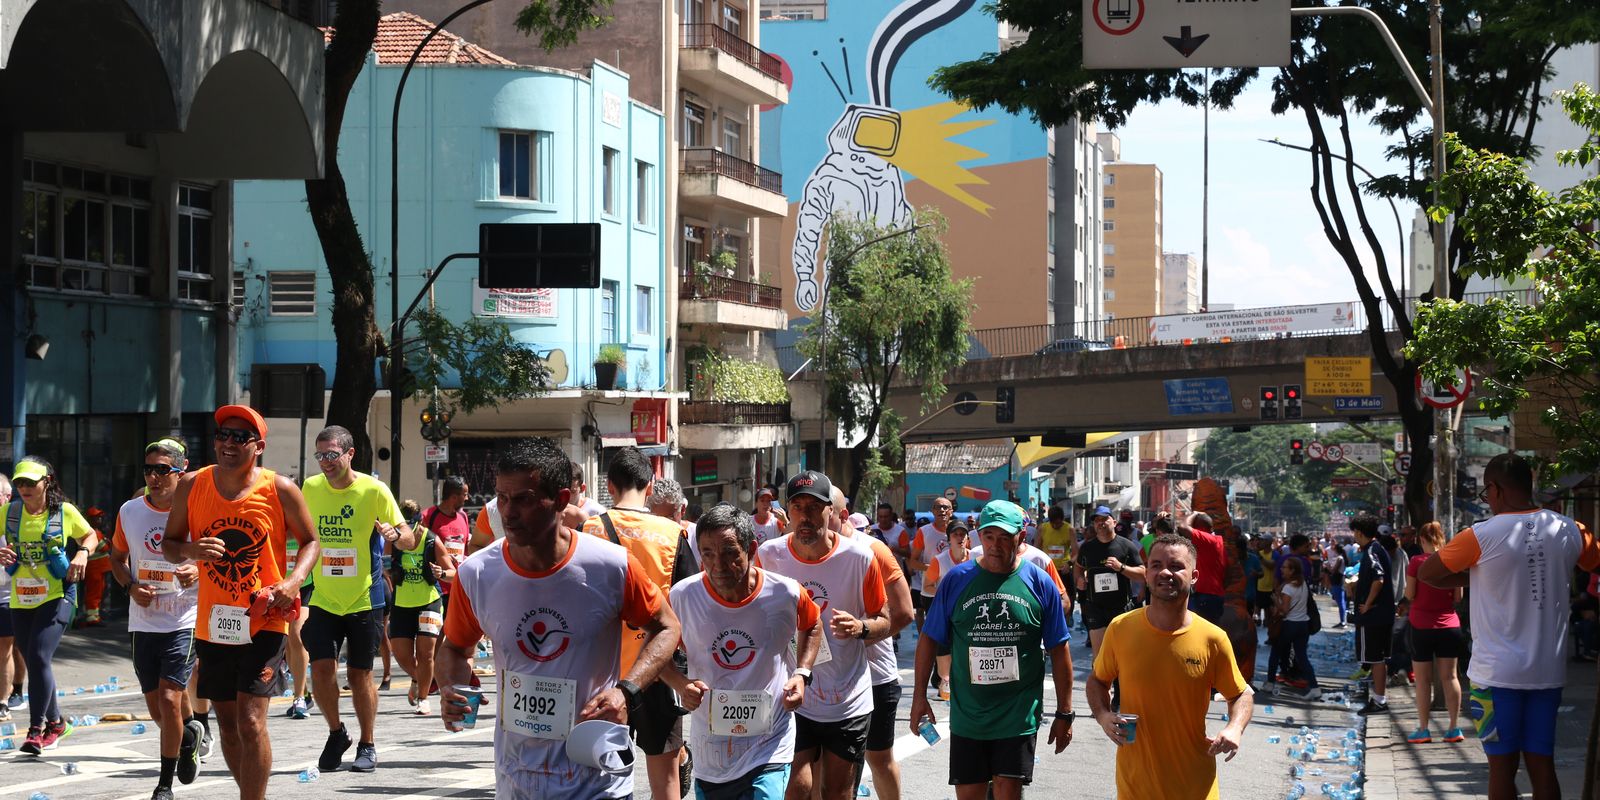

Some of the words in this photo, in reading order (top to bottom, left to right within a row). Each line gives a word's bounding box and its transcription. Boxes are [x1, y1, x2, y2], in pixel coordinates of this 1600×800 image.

[1217, 311, 1263, 320] INTERNACIONAL
[1273, 308, 1285, 316] SÃO
[1286, 307, 1318, 315] SILVESTRE
[1255, 317, 1293, 325] INTERDITADA
[1336, 399, 1345, 407] 13
[1348, 399, 1358, 407] de
[1361, 399, 1381, 407] Maio
[1328, 447, 1340, 457] 50
[319, 515, 343, 525] run
[202, 517, 263, 541] EQUIPE
[318, 525, 352, 537] team
[329, 557, 345, 566] 2293
[148, 569, 164, 581] 4303
[203, 562, 238, 593] FENIX
[241, 565, 262, 592] RUN
[810, 581, 828, 597] SILVESTRE
[963, 597, 976, 610] EQUIPE
[976, 593, 996, 602] CHICLETE
[995, 593, 1015, 601] CORRIDA
[1014, 595, 1021, 604] DE
[218, 617, 241, 631] 20978
[521, 609, 536, 623] SÃO
[538, 608, 569, 630] SILVESTRE
[973, 622, 1002, 630] JACAREÍ
[717, 630, 729, 641] SÃO
[731, 629, 755, 646] SILVESTRE
[995, 649, 1012, 657] 60+
[980, 659, 1004, 670] 28971
[514, 693, 556, 716] 21992
[723, 706, 756, 719] 22097
